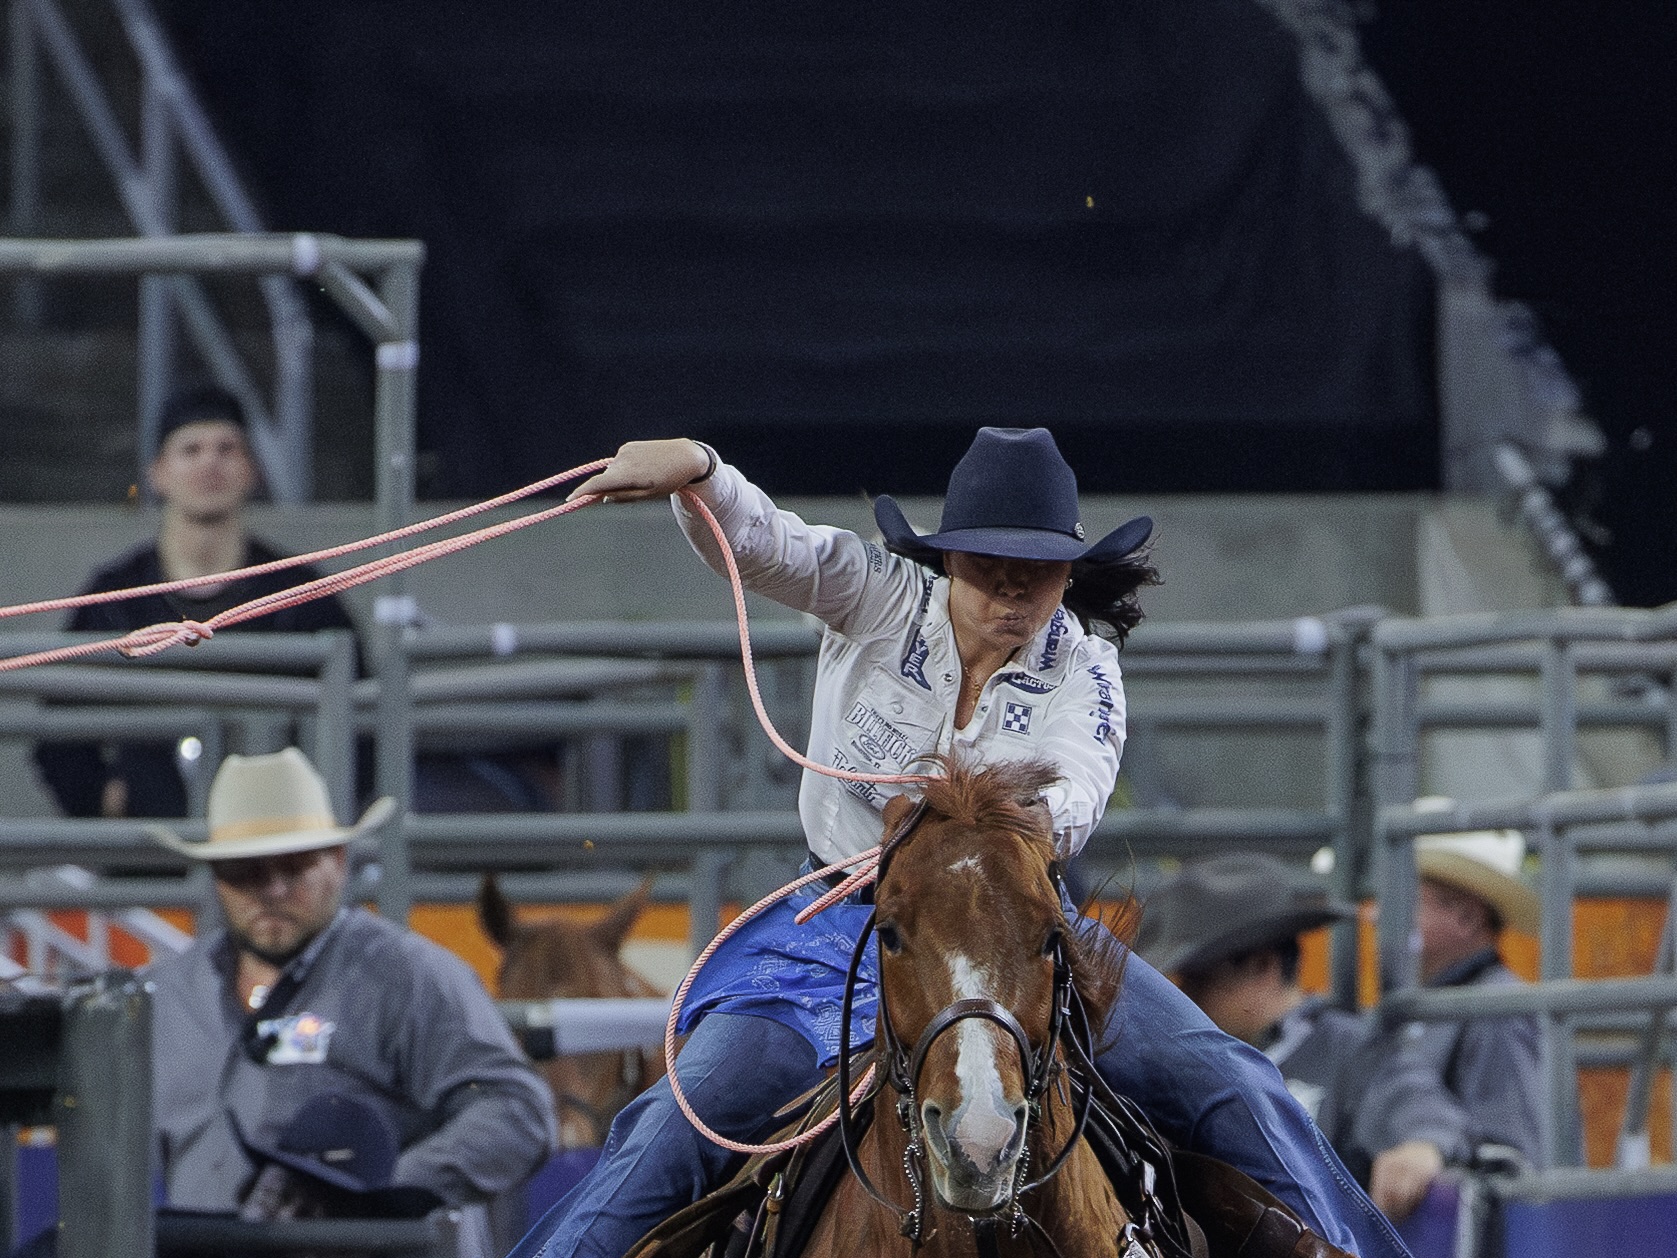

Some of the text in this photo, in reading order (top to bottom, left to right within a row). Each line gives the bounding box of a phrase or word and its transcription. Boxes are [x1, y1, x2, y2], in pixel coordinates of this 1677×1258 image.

[1038, 608, 1069, 672] Wrangler
[845, 701, 881, 743] BILL
[1087, 664, 1117, 747] Wranger
